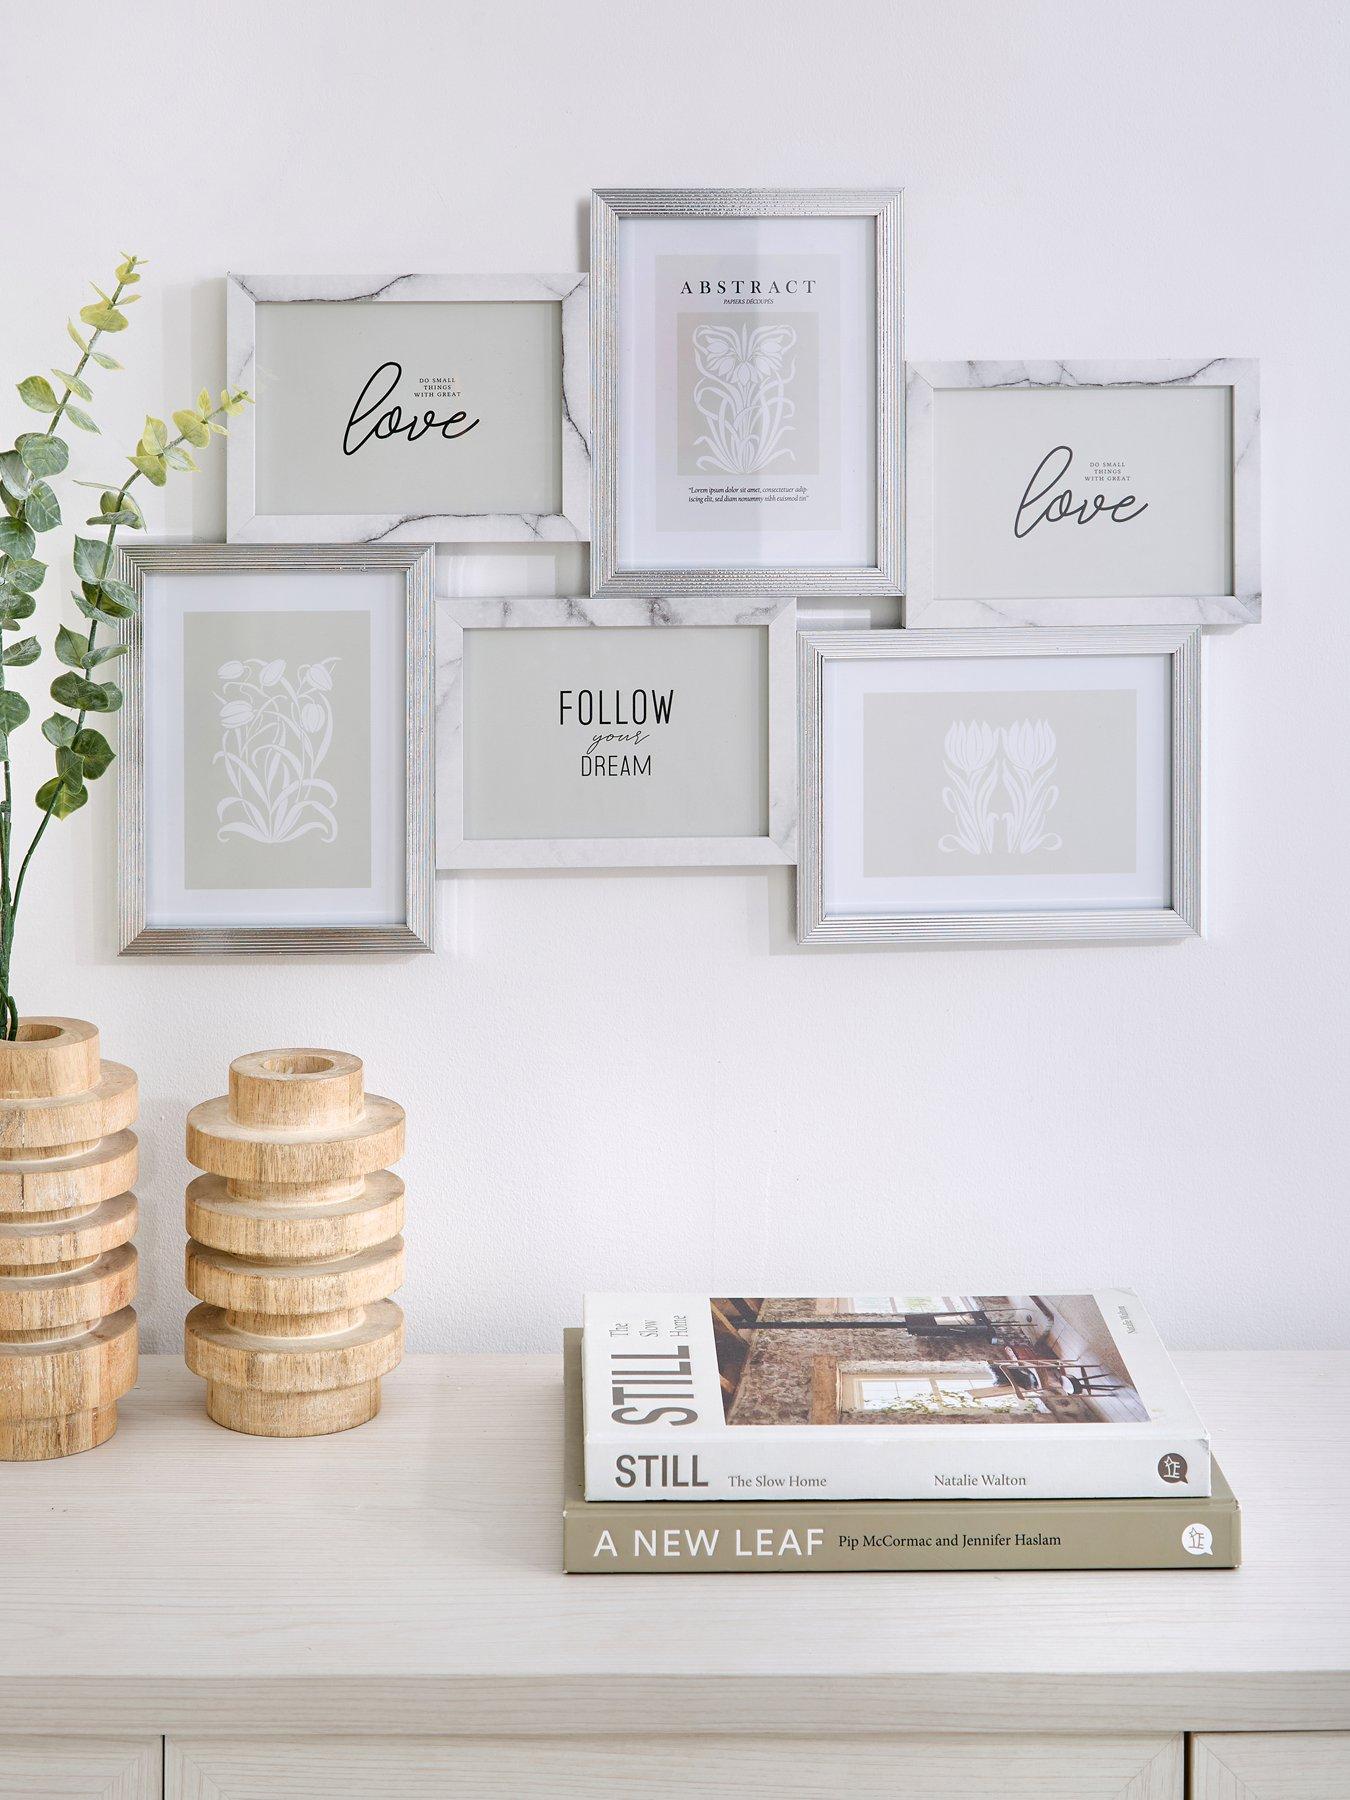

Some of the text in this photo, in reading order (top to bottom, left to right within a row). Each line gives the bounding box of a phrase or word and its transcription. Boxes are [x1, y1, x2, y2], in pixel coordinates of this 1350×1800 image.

[680, 279, 817, 295] ABSTRACT
[343, 361, 480, 456] love
[1014, 445, 1149, 539] love
[560, 689, 674, 726] FOLLOW
[586, 730, 650, 755] your
[581, 755, 651, 777] DREAM
[609, 1322, 629, 1338] The
[638, 1319, 659, 1338] Slow
[669, 1314, 689, 1337] Home
[611, 1345, 698, 1426] STILL
[615, 1454, 709, 1488] STILL
[727, 1475, 827, 1488] The Slow Home
[934, 1473, 1027, 1487] Natalie Walton
[593, 1528, 824, 1557] A NEW LEAF
[838, 1533, 1062, 1550] Pip McCormac and Jennifer Haslam
